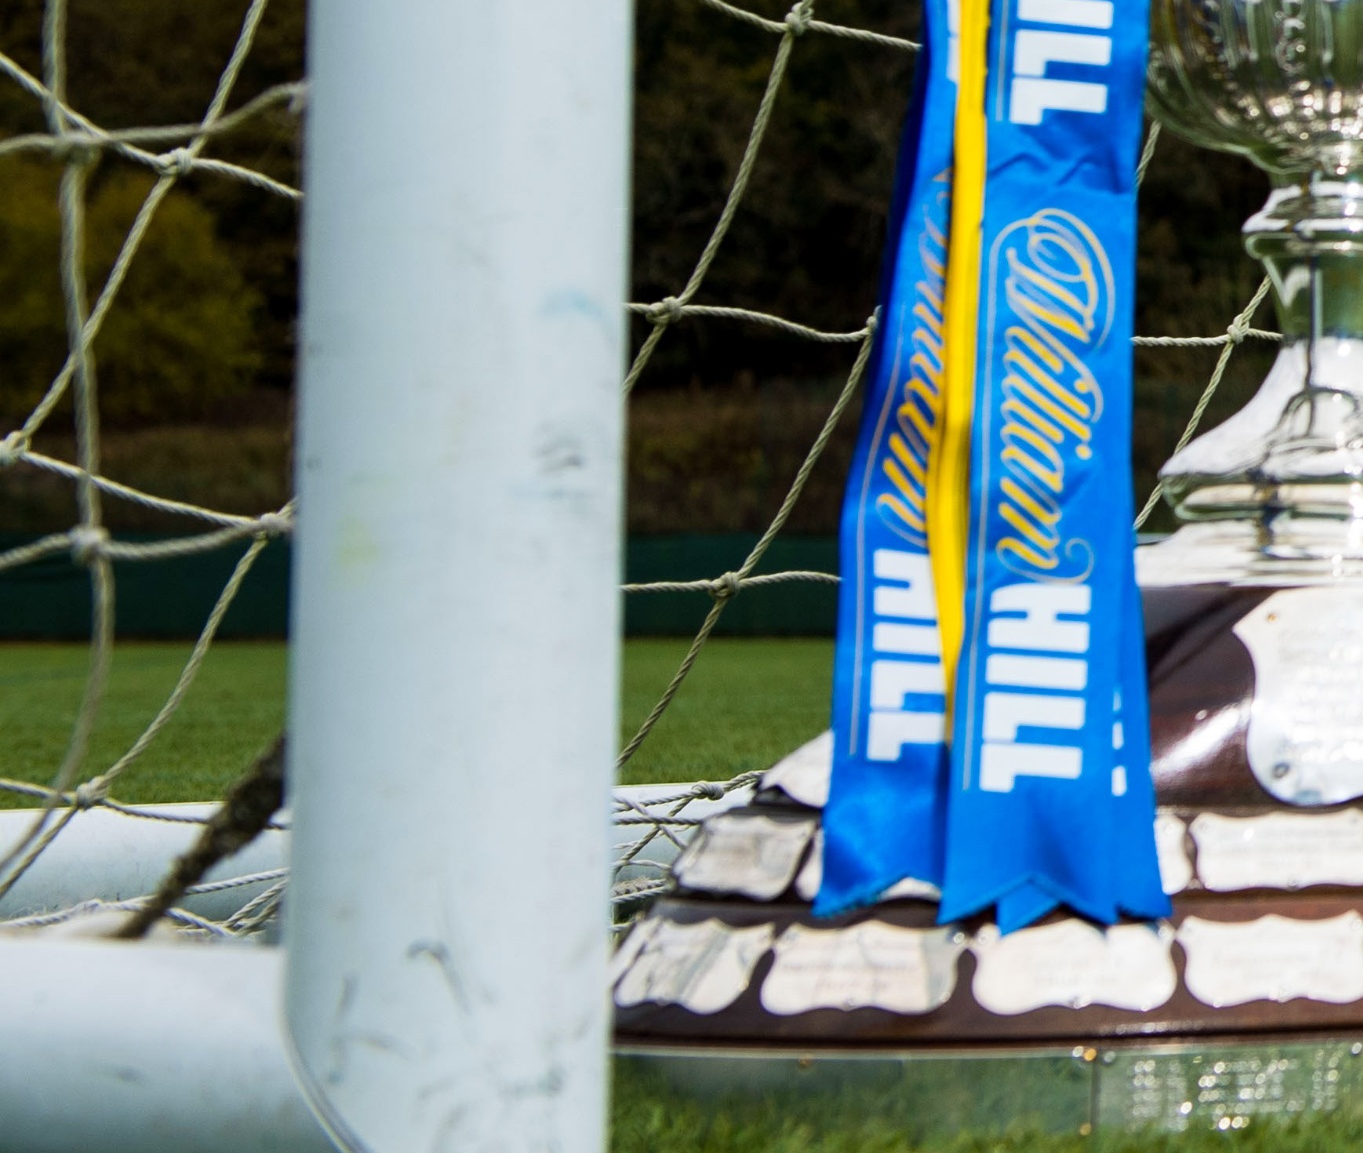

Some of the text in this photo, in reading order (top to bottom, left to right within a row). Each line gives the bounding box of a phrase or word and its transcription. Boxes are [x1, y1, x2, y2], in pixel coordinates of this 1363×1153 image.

[865, 547, 948, 763] HILL
[978, 207, 1117, 794] William HILL
